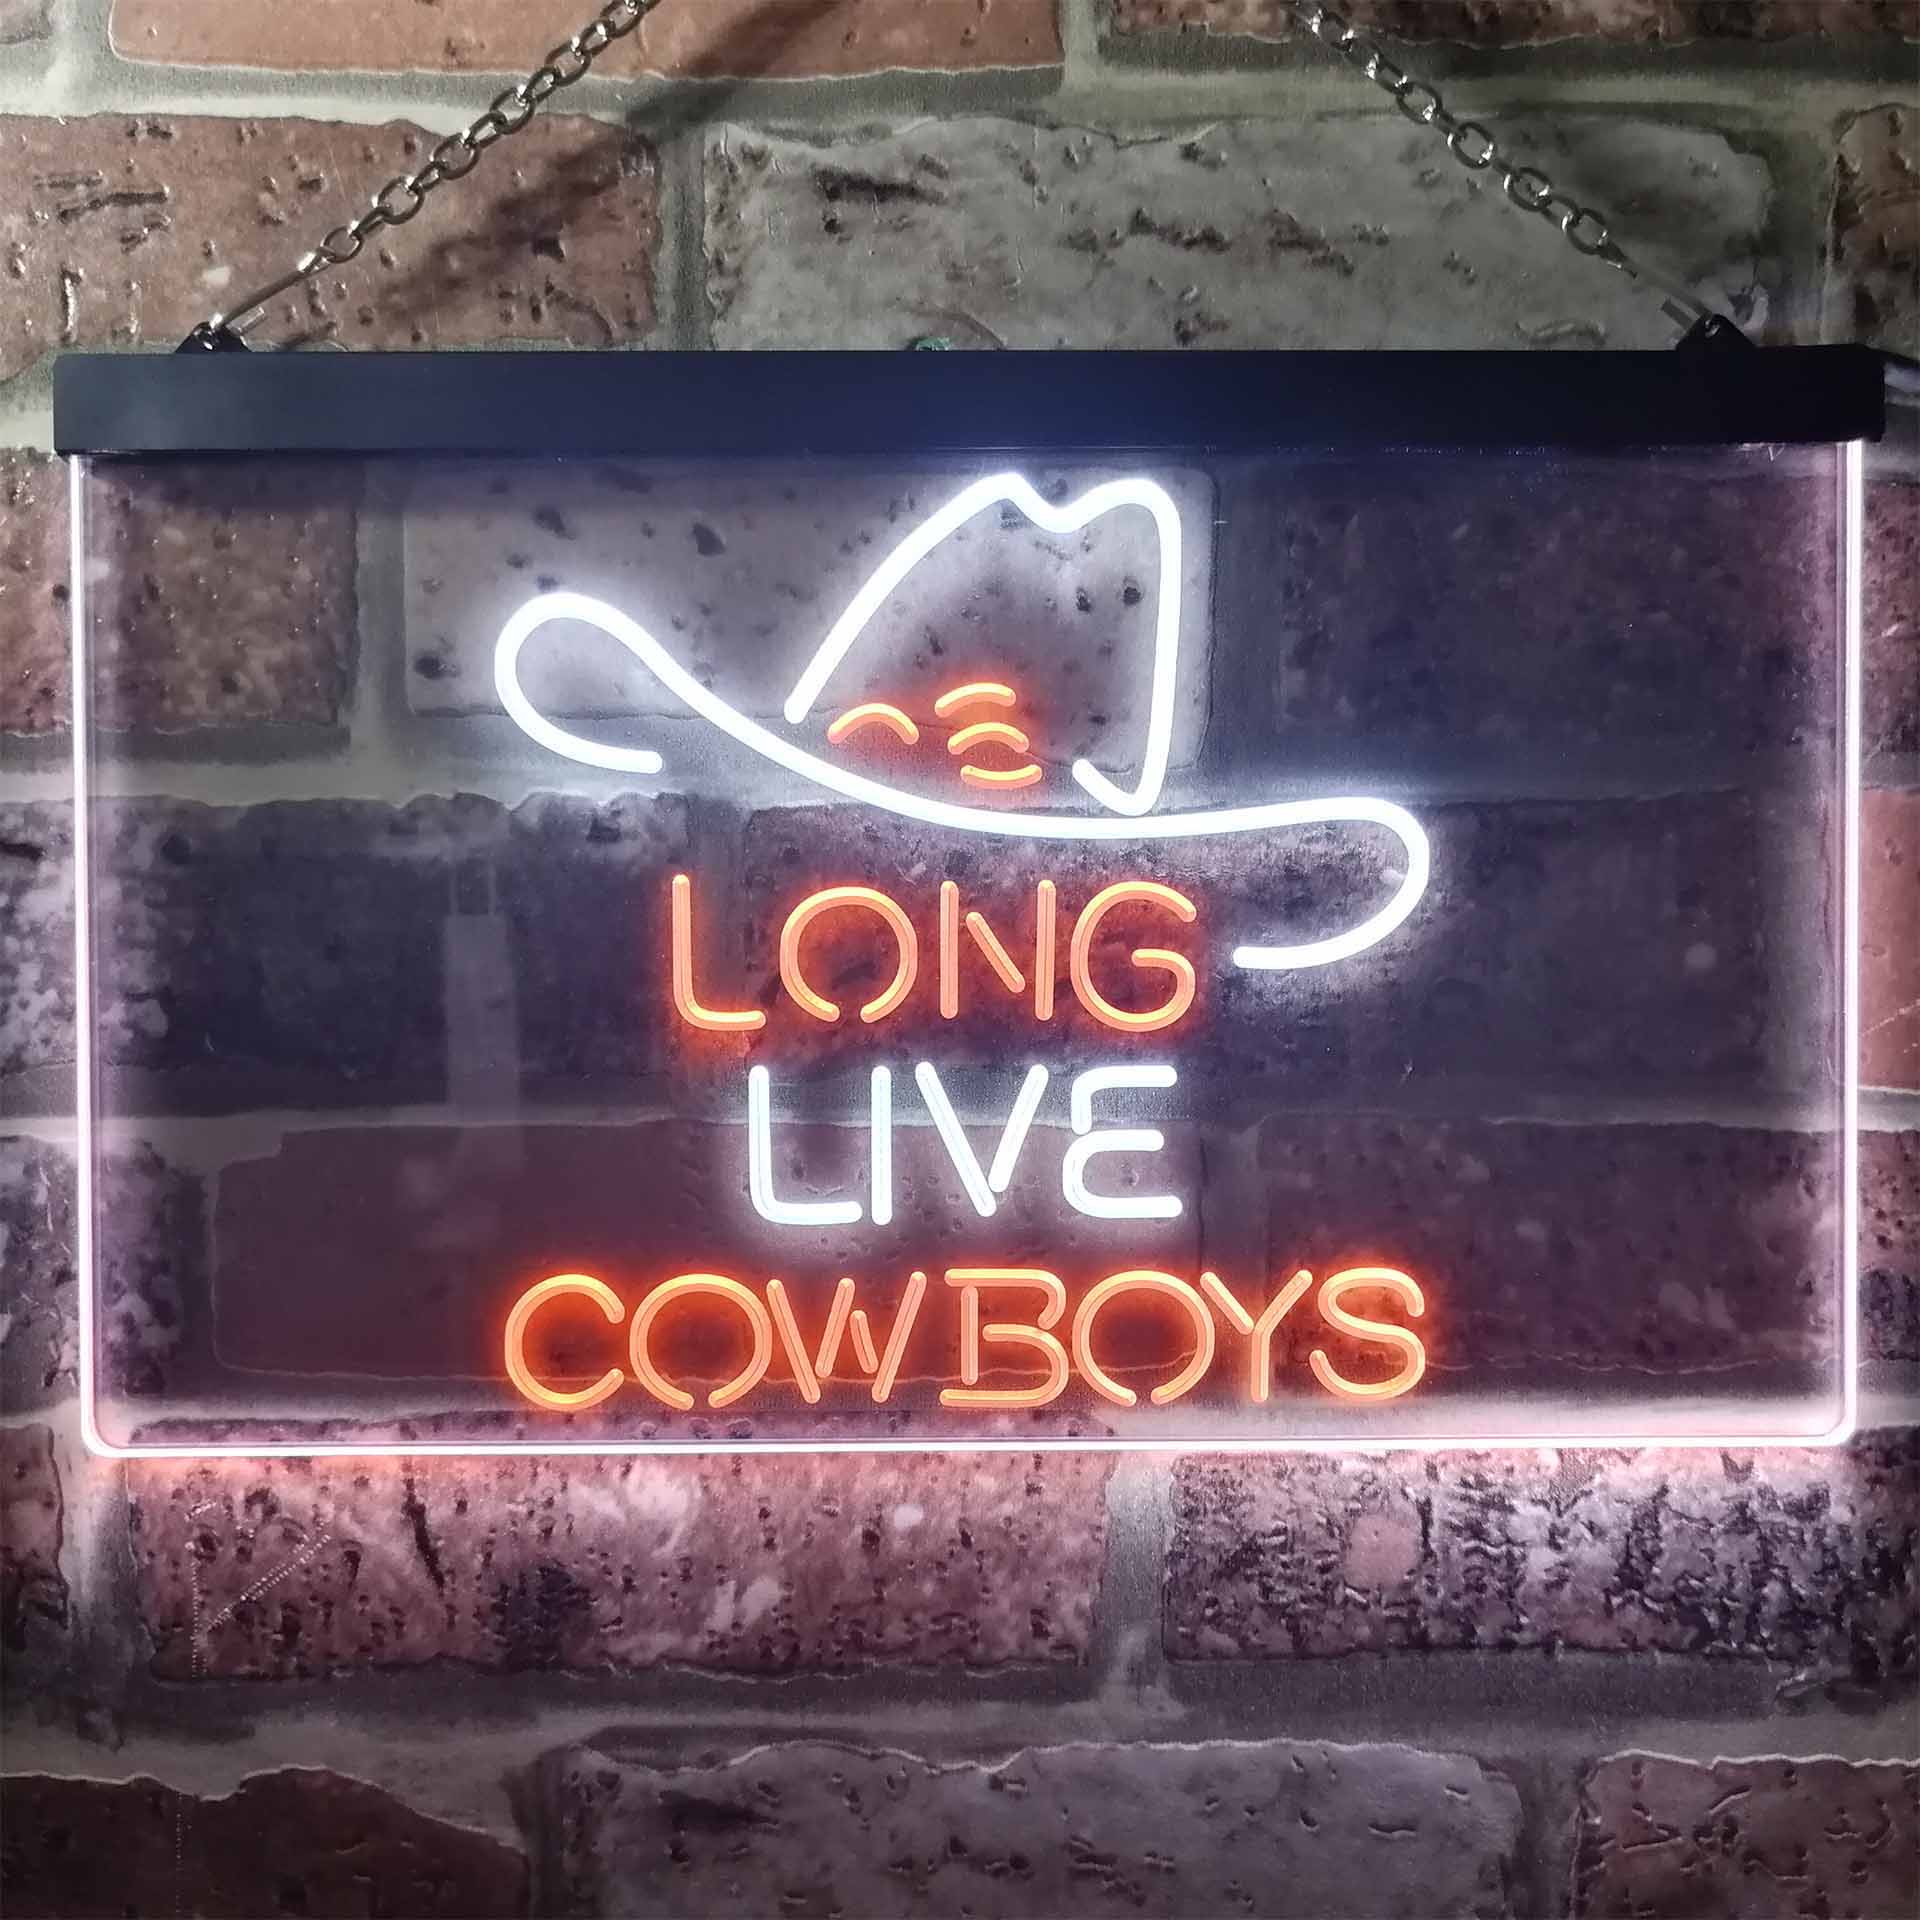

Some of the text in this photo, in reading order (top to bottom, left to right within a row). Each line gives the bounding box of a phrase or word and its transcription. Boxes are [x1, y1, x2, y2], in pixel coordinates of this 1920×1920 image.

[671, 873, 1197, 1032] LONG
[747, 1061, 1183, 1225] LIVE
[504, 1266, 1428, 1411] COWBOYS
